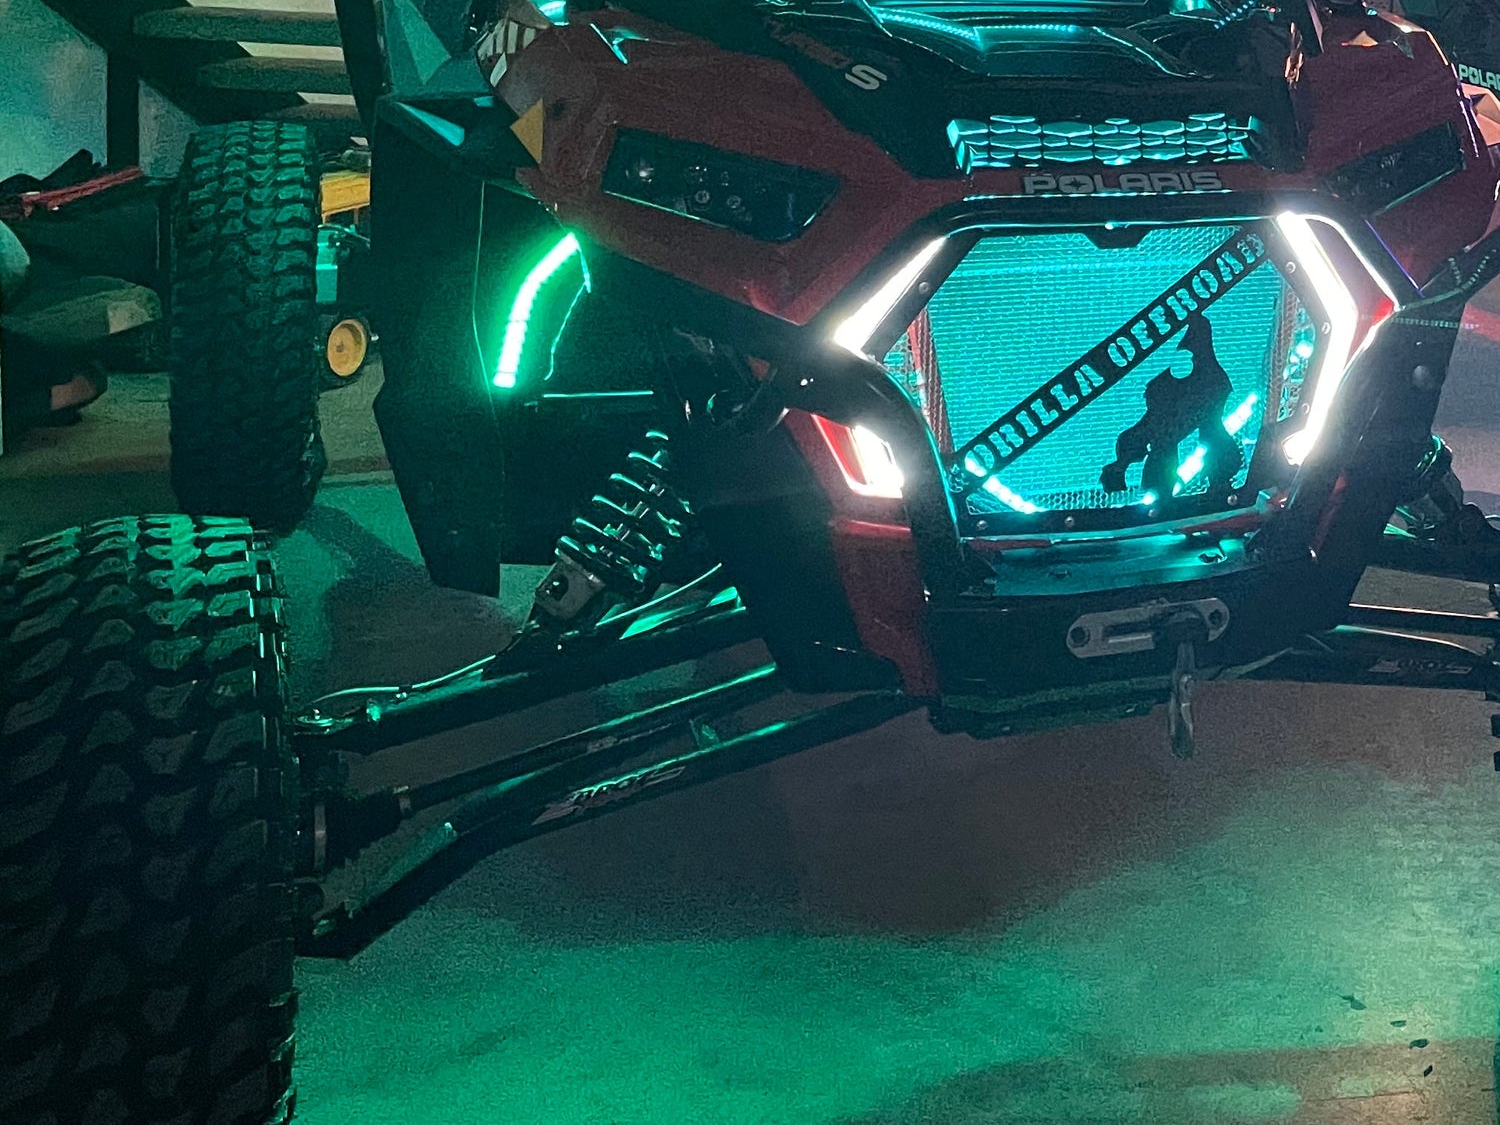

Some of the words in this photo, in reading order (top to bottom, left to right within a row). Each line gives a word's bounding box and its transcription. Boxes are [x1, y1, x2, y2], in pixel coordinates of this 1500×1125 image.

[1024, 171, 1223, 194] POLARIS
[952, 364, 1105, 491] ORILLA
[1107, 233, 1265, 367] OFFROAD
